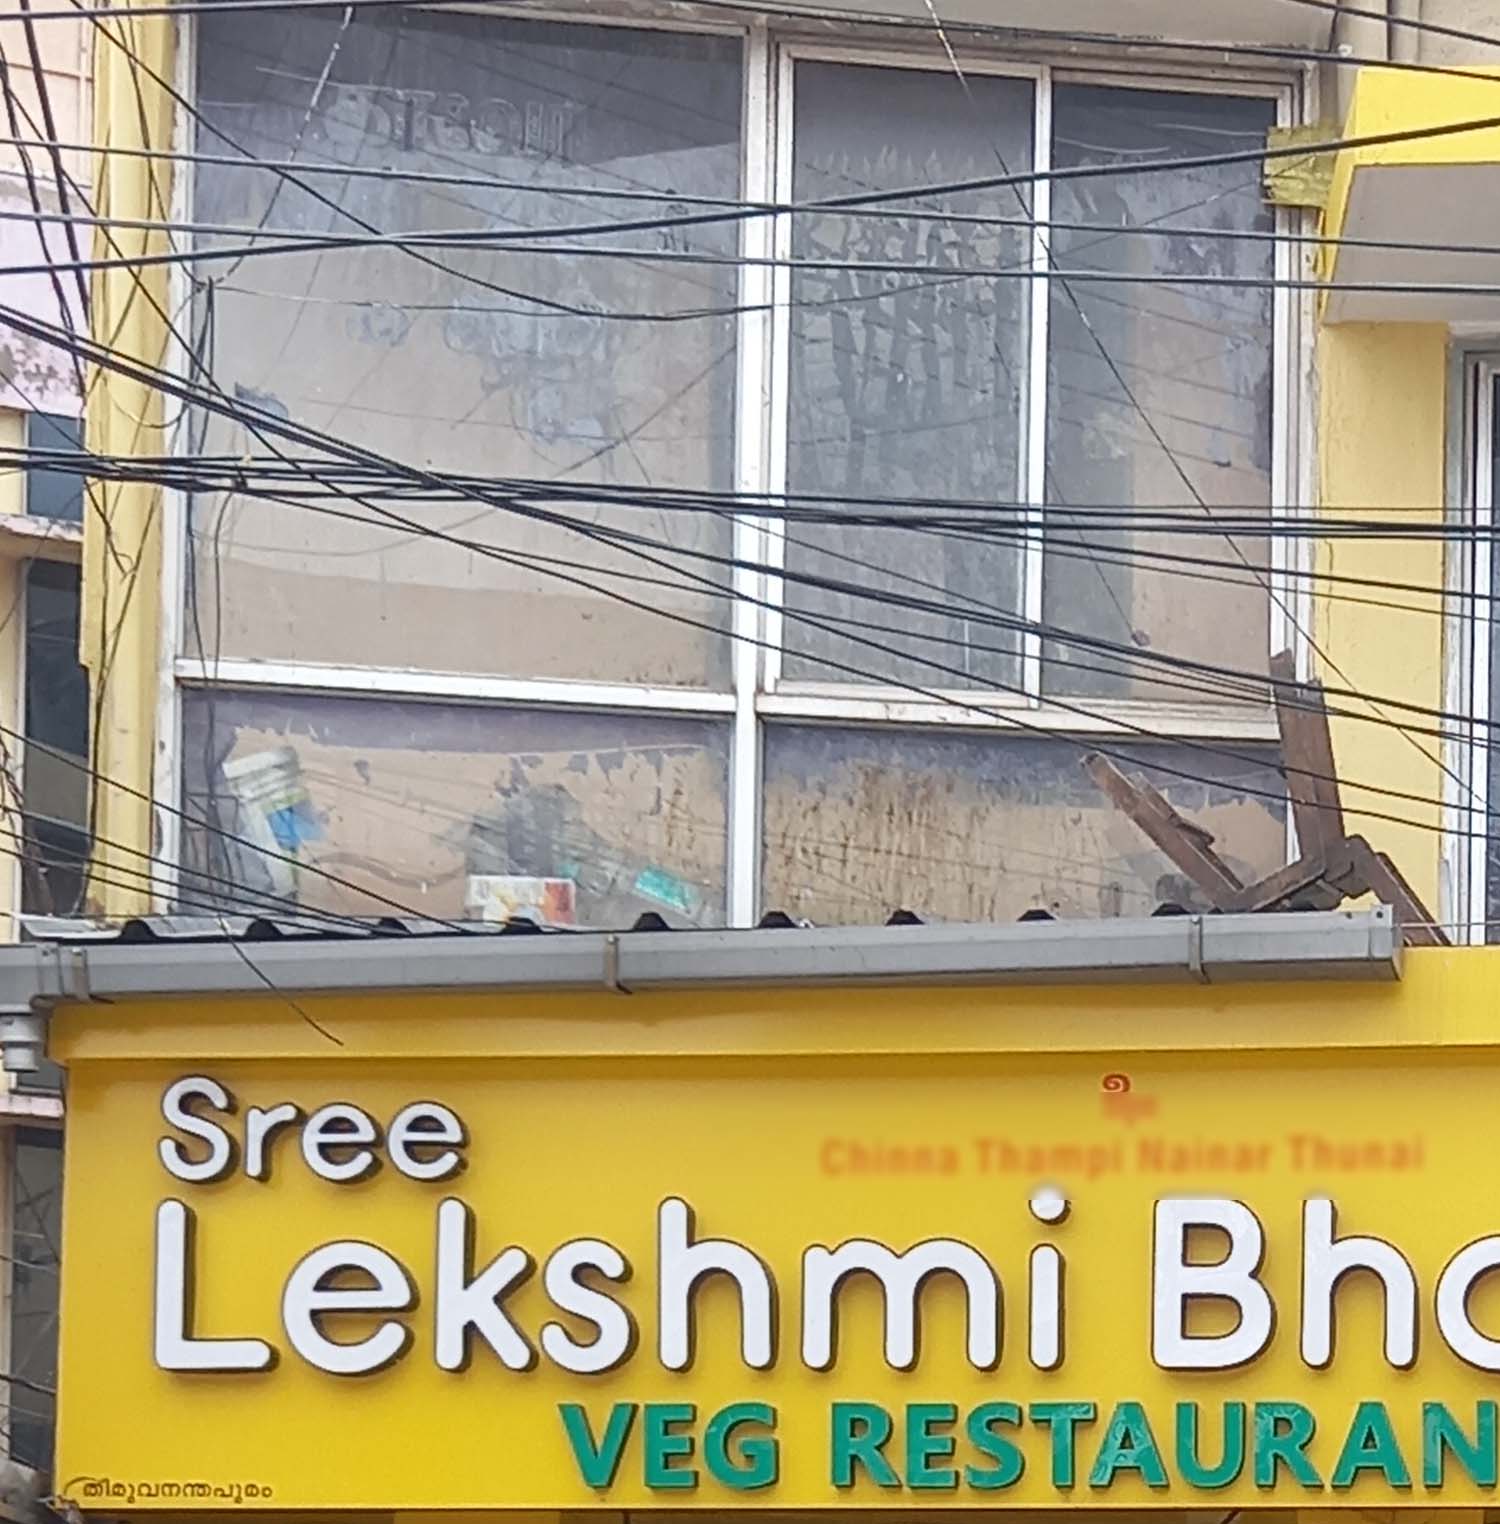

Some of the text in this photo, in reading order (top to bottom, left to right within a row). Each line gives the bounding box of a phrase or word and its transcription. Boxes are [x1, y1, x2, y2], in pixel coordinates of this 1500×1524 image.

[159, 1076, 467, 1182] Sree
[154, 1186, 1072, 1376] Lekshmi
[83, 1477, 273, 1504] തിരുവനന്തപുരം
[558, 1401, 780, 1491] VEG
